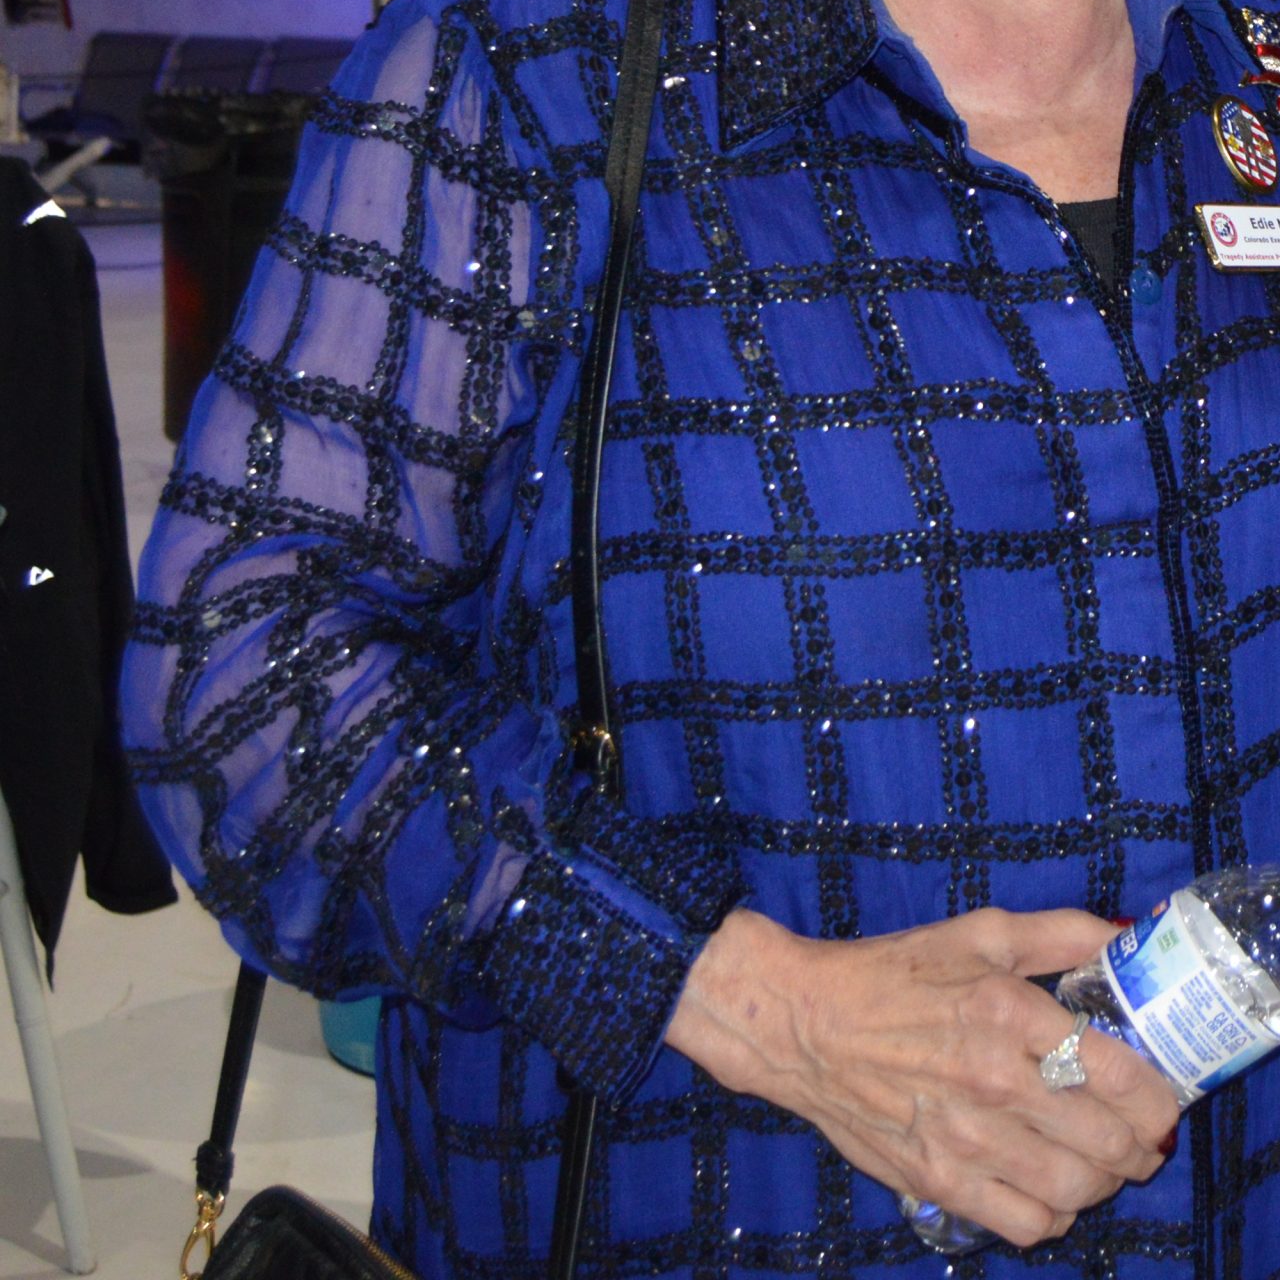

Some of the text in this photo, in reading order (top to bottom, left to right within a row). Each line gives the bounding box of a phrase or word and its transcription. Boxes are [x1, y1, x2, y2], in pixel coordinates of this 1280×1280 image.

[1249, 217, 1276, 230] Edie
[1243, 236, 1269, 244] Colorado
[1220, 253, 1244, 261] Tragedy
[1245, 253, 1275, 261] Assistance
[1119, 925, 1139, 958] TER
[1213, 1012, 1229, 1027] CA
